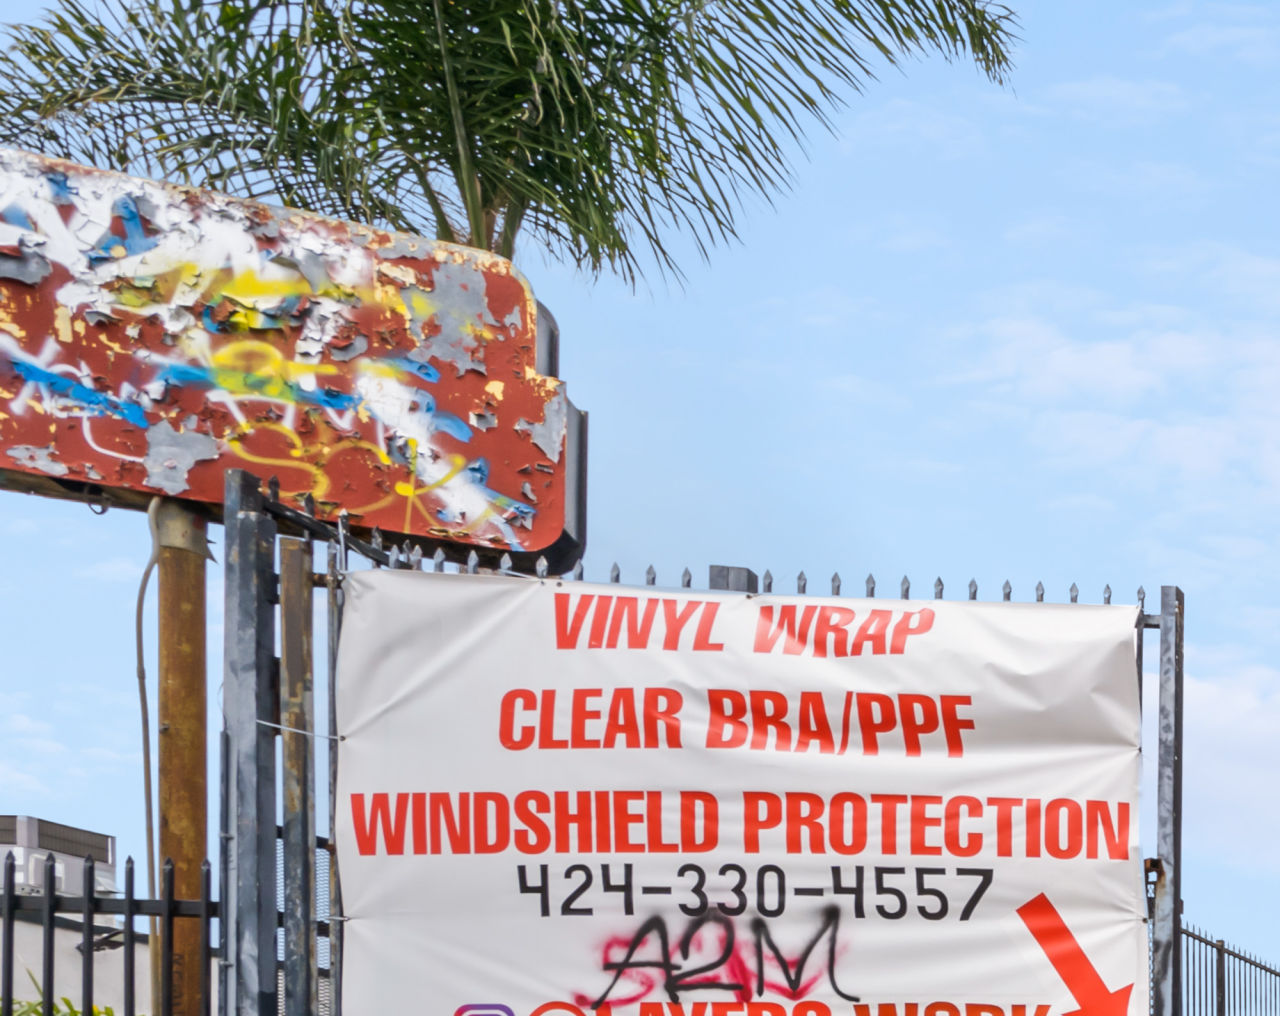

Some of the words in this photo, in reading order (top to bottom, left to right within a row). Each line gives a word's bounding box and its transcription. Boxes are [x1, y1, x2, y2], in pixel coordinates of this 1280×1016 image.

[554, 593, 724, 651] VINYL
[753, 605, 935, 658] WRAP
[499, 687, 683, 751] CLEAR
[706, 689, 975, 757] BRA/PPF
[351, 790, 719, 856] WINDSHIELD
[743, 791, 1130, 861] PROTECTION
[517, 863, 994, 922] 424-330-4557
